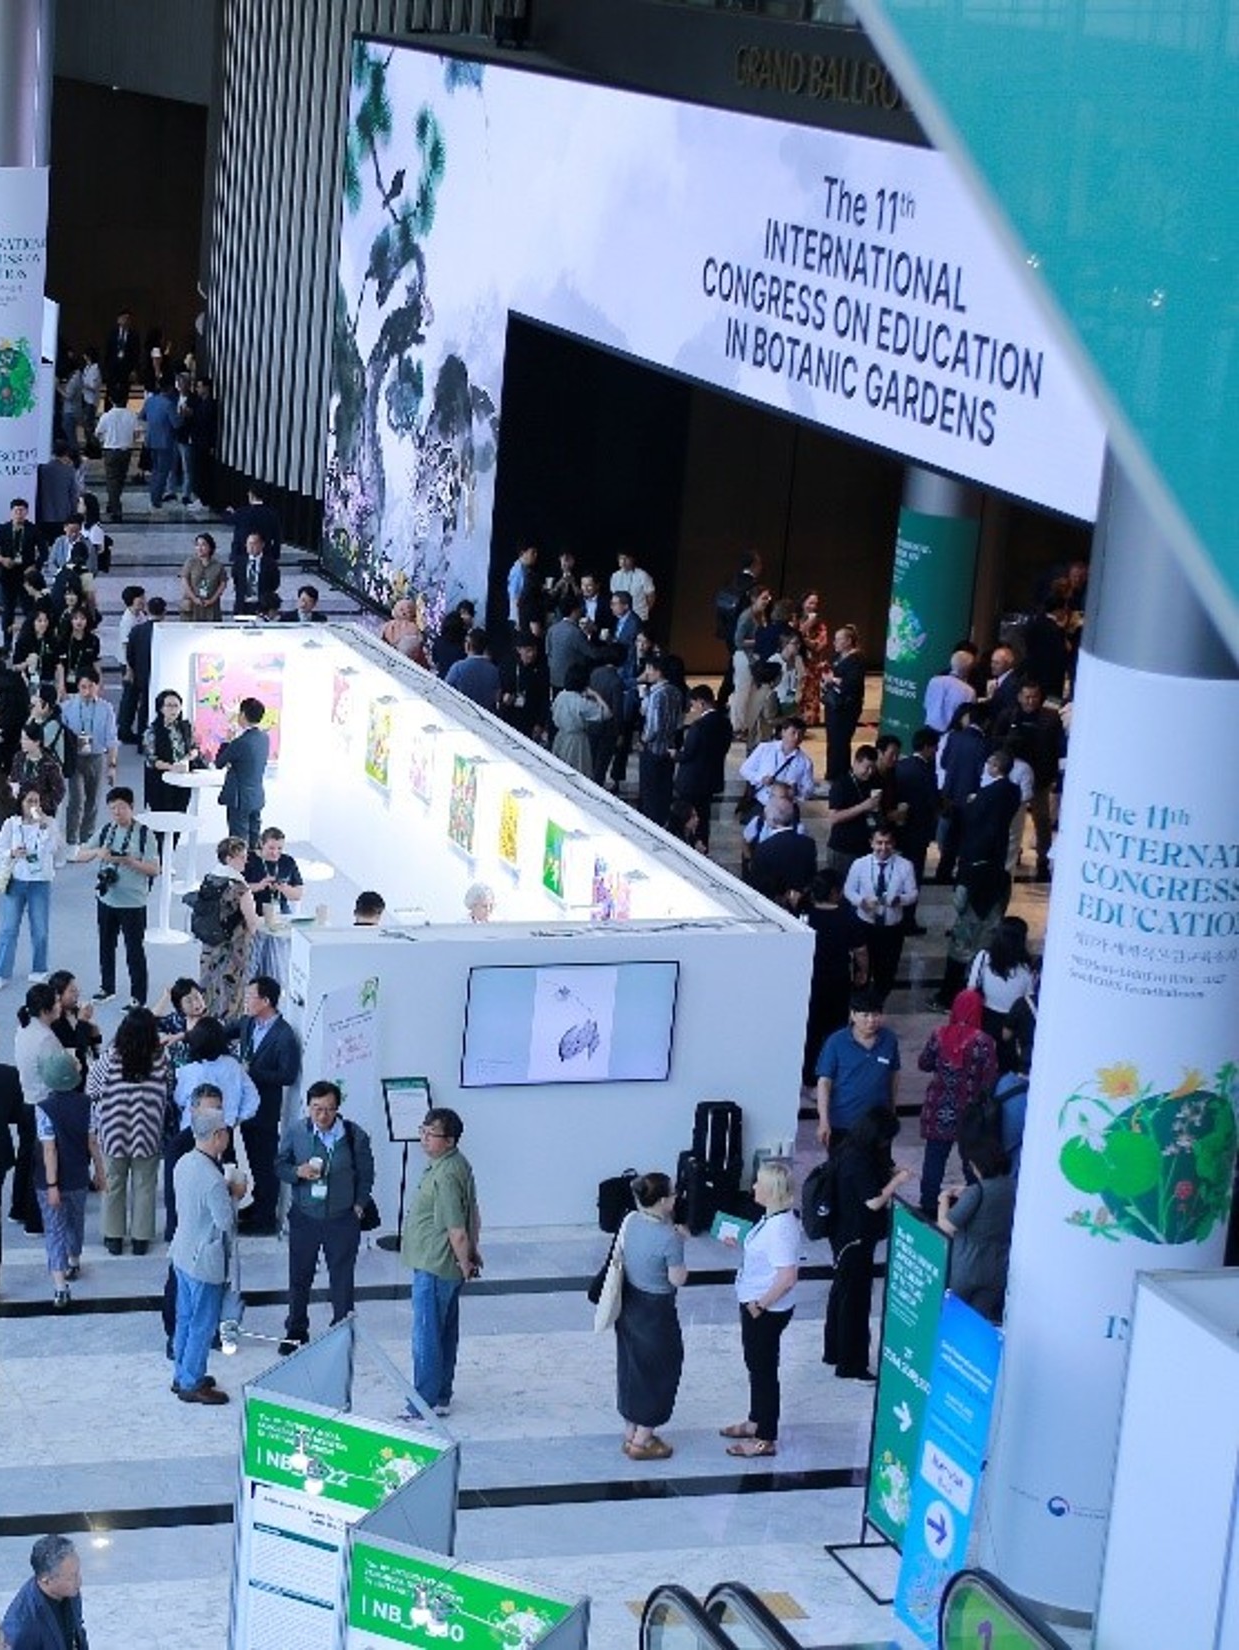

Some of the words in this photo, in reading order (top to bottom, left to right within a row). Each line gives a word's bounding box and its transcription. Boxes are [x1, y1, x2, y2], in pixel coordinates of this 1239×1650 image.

[733, 44, 804, 94] GRAND
[811, 55, 903, 110] BALLRO
[824, 176, 868, 227] The
[876, 188, 915, 234] 11th
[763, 218, 967, 314] INTERNATIONAL
[702, 257, 828, 332] CONGRESS
[833, 296, 871, 346] ON
[876, 306, 1044, 400] EDUCATION
[725, 317, 748, 362] IN
[752, 327, 859, 400] BOTANIC
[865, 363, 997, 447] GARDENS
[1089, 790, 1137, 826] The
[1146, 804, 1190, 831] 11th
[1077, 893, 1239, 937] EDUCATIO
